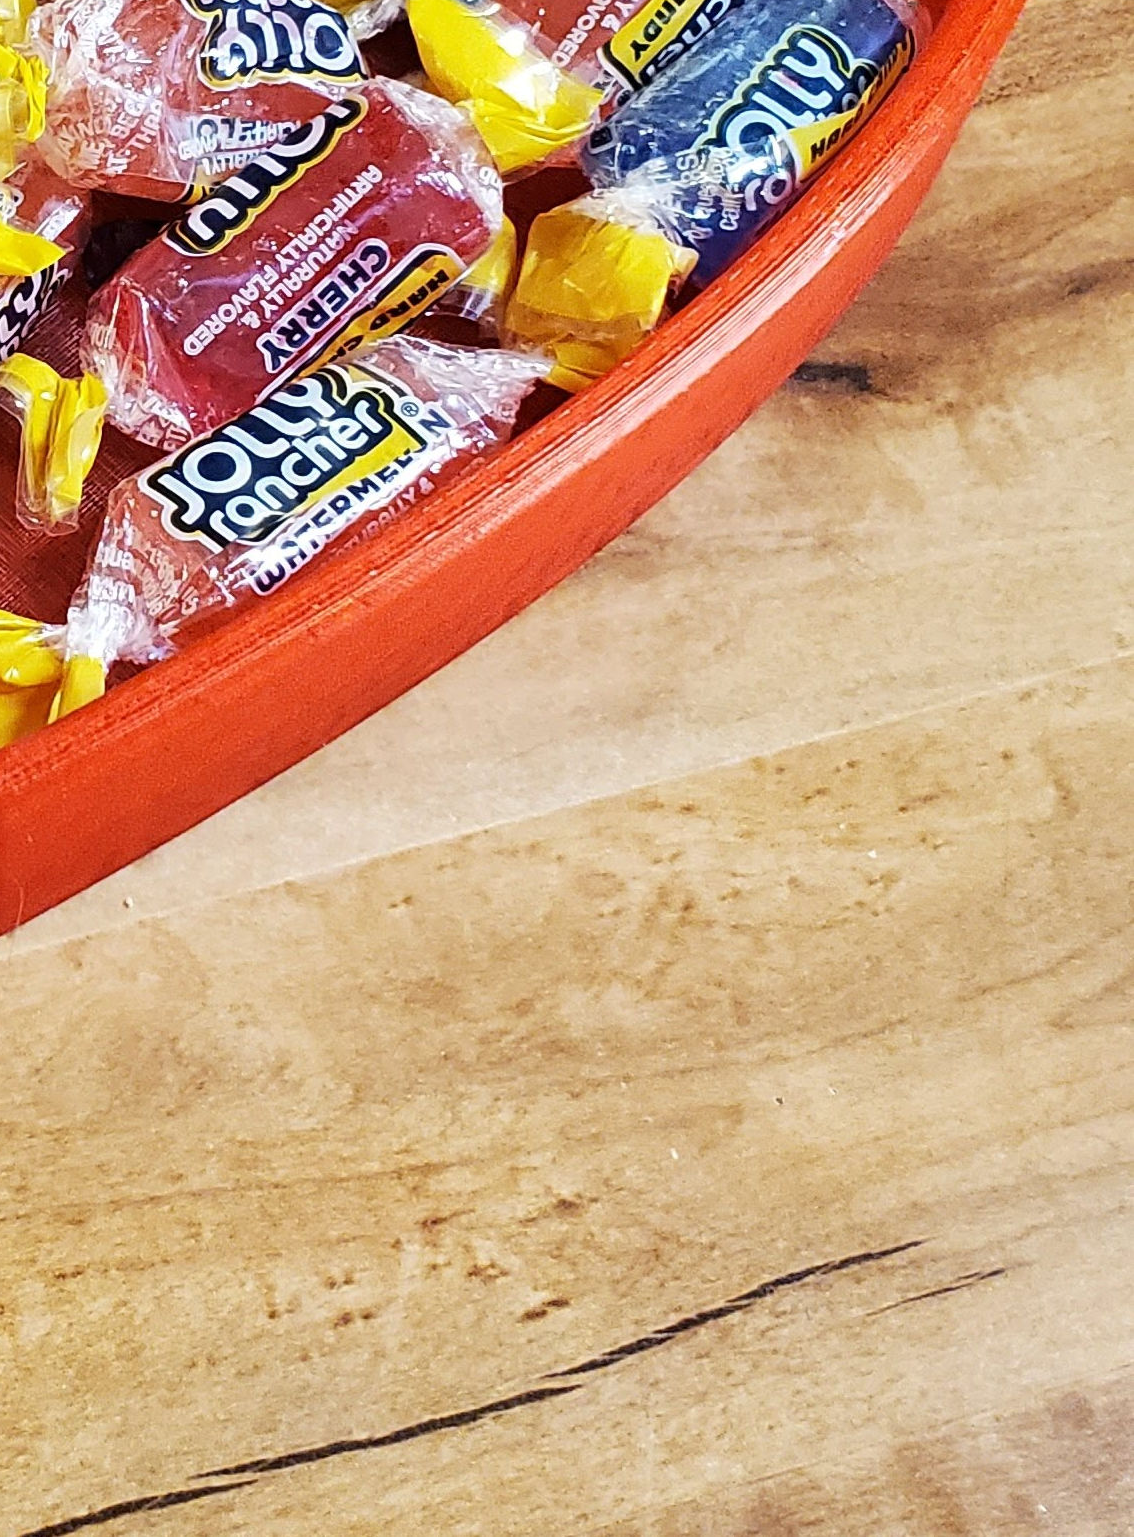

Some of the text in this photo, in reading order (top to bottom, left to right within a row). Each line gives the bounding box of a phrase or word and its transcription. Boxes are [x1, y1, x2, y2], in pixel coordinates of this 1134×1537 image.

[215, 10, 352, 74] OLLY
[726, 38, 844, 155] OLLY
[183, 163, 384, 356] ARTIFICIALLY FLAVORED
[256, 218, 358, 317] NATURALLY
[256, 238, 393, 372] CHERRY
[366, 268, 451, 336] HARD
[158, 377, 326, 525] JOLLY
[209, 400, 381, 542] rancher
[256, 407, 442, 588] WATERMELN
